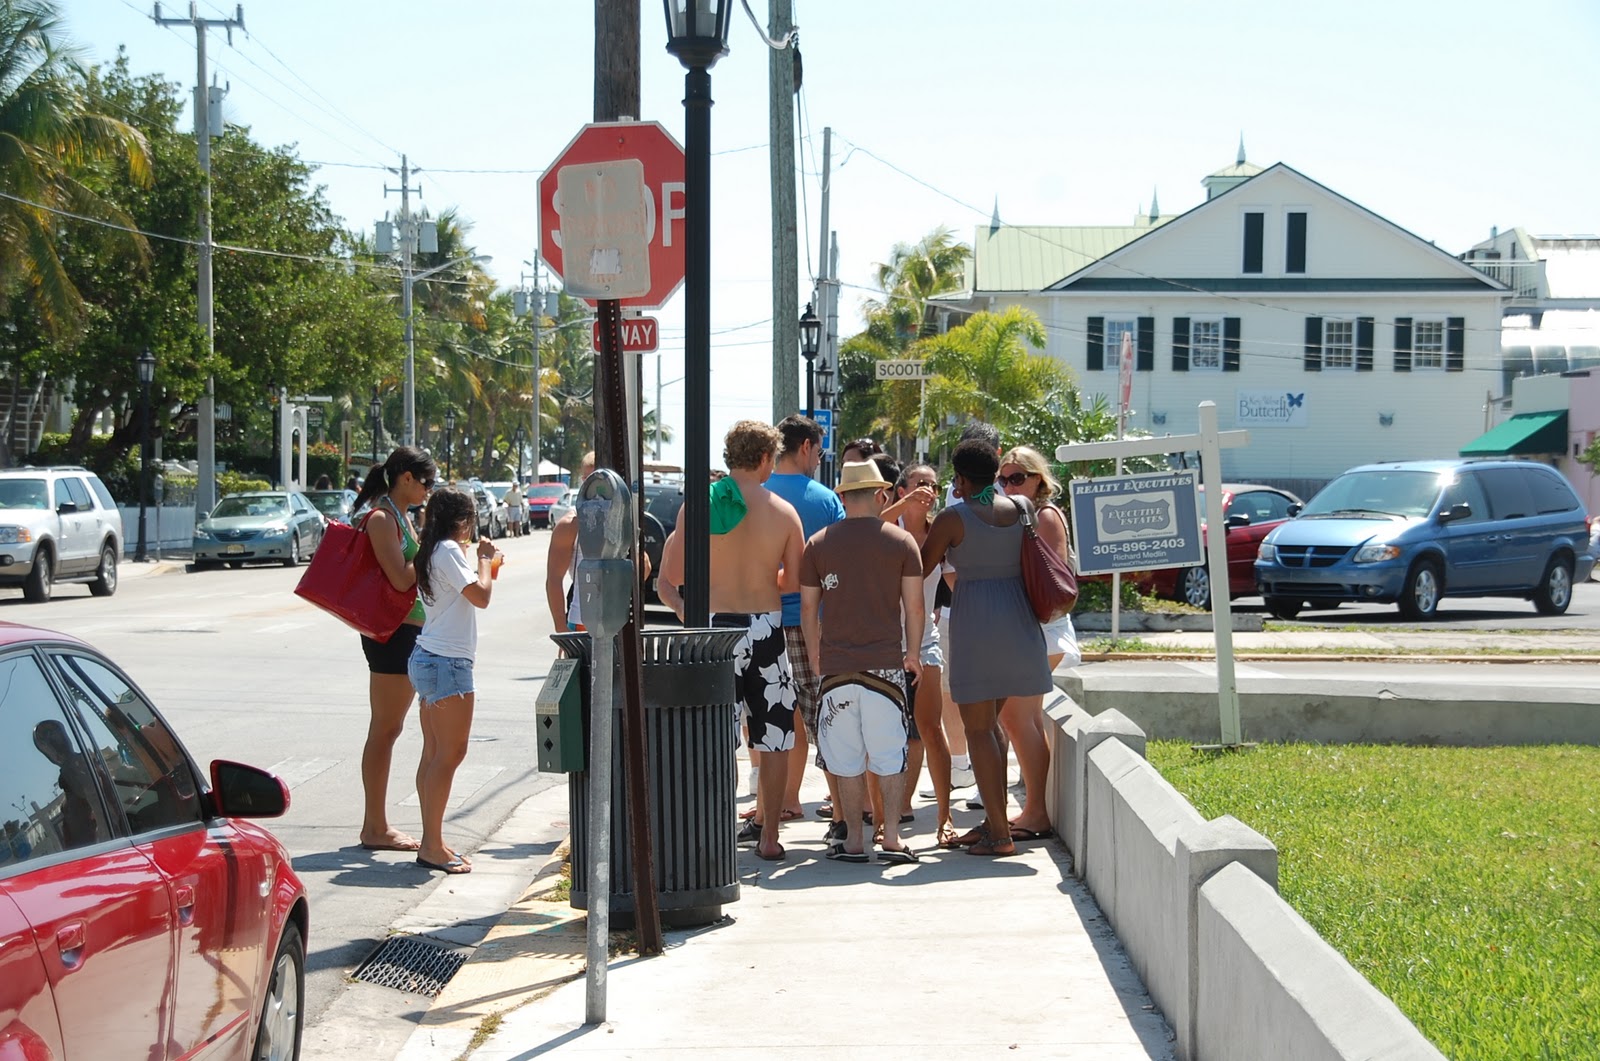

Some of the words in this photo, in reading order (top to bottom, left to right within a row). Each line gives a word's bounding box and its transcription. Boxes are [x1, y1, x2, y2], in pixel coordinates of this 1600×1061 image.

[1239, 396, 1295, 422] Butterfly
[1075, 483, 1121, 494] REALTY
[1123, 476, 1193, 492] EXECUTIVES
[1108, 508, 1163, 519] EXECUTIVE
[1092, 538, 1186, 555] 305-896-2403
[1113, 553, 1141, 561] Richard
[1142, 550, 1167, 558] Medlin
